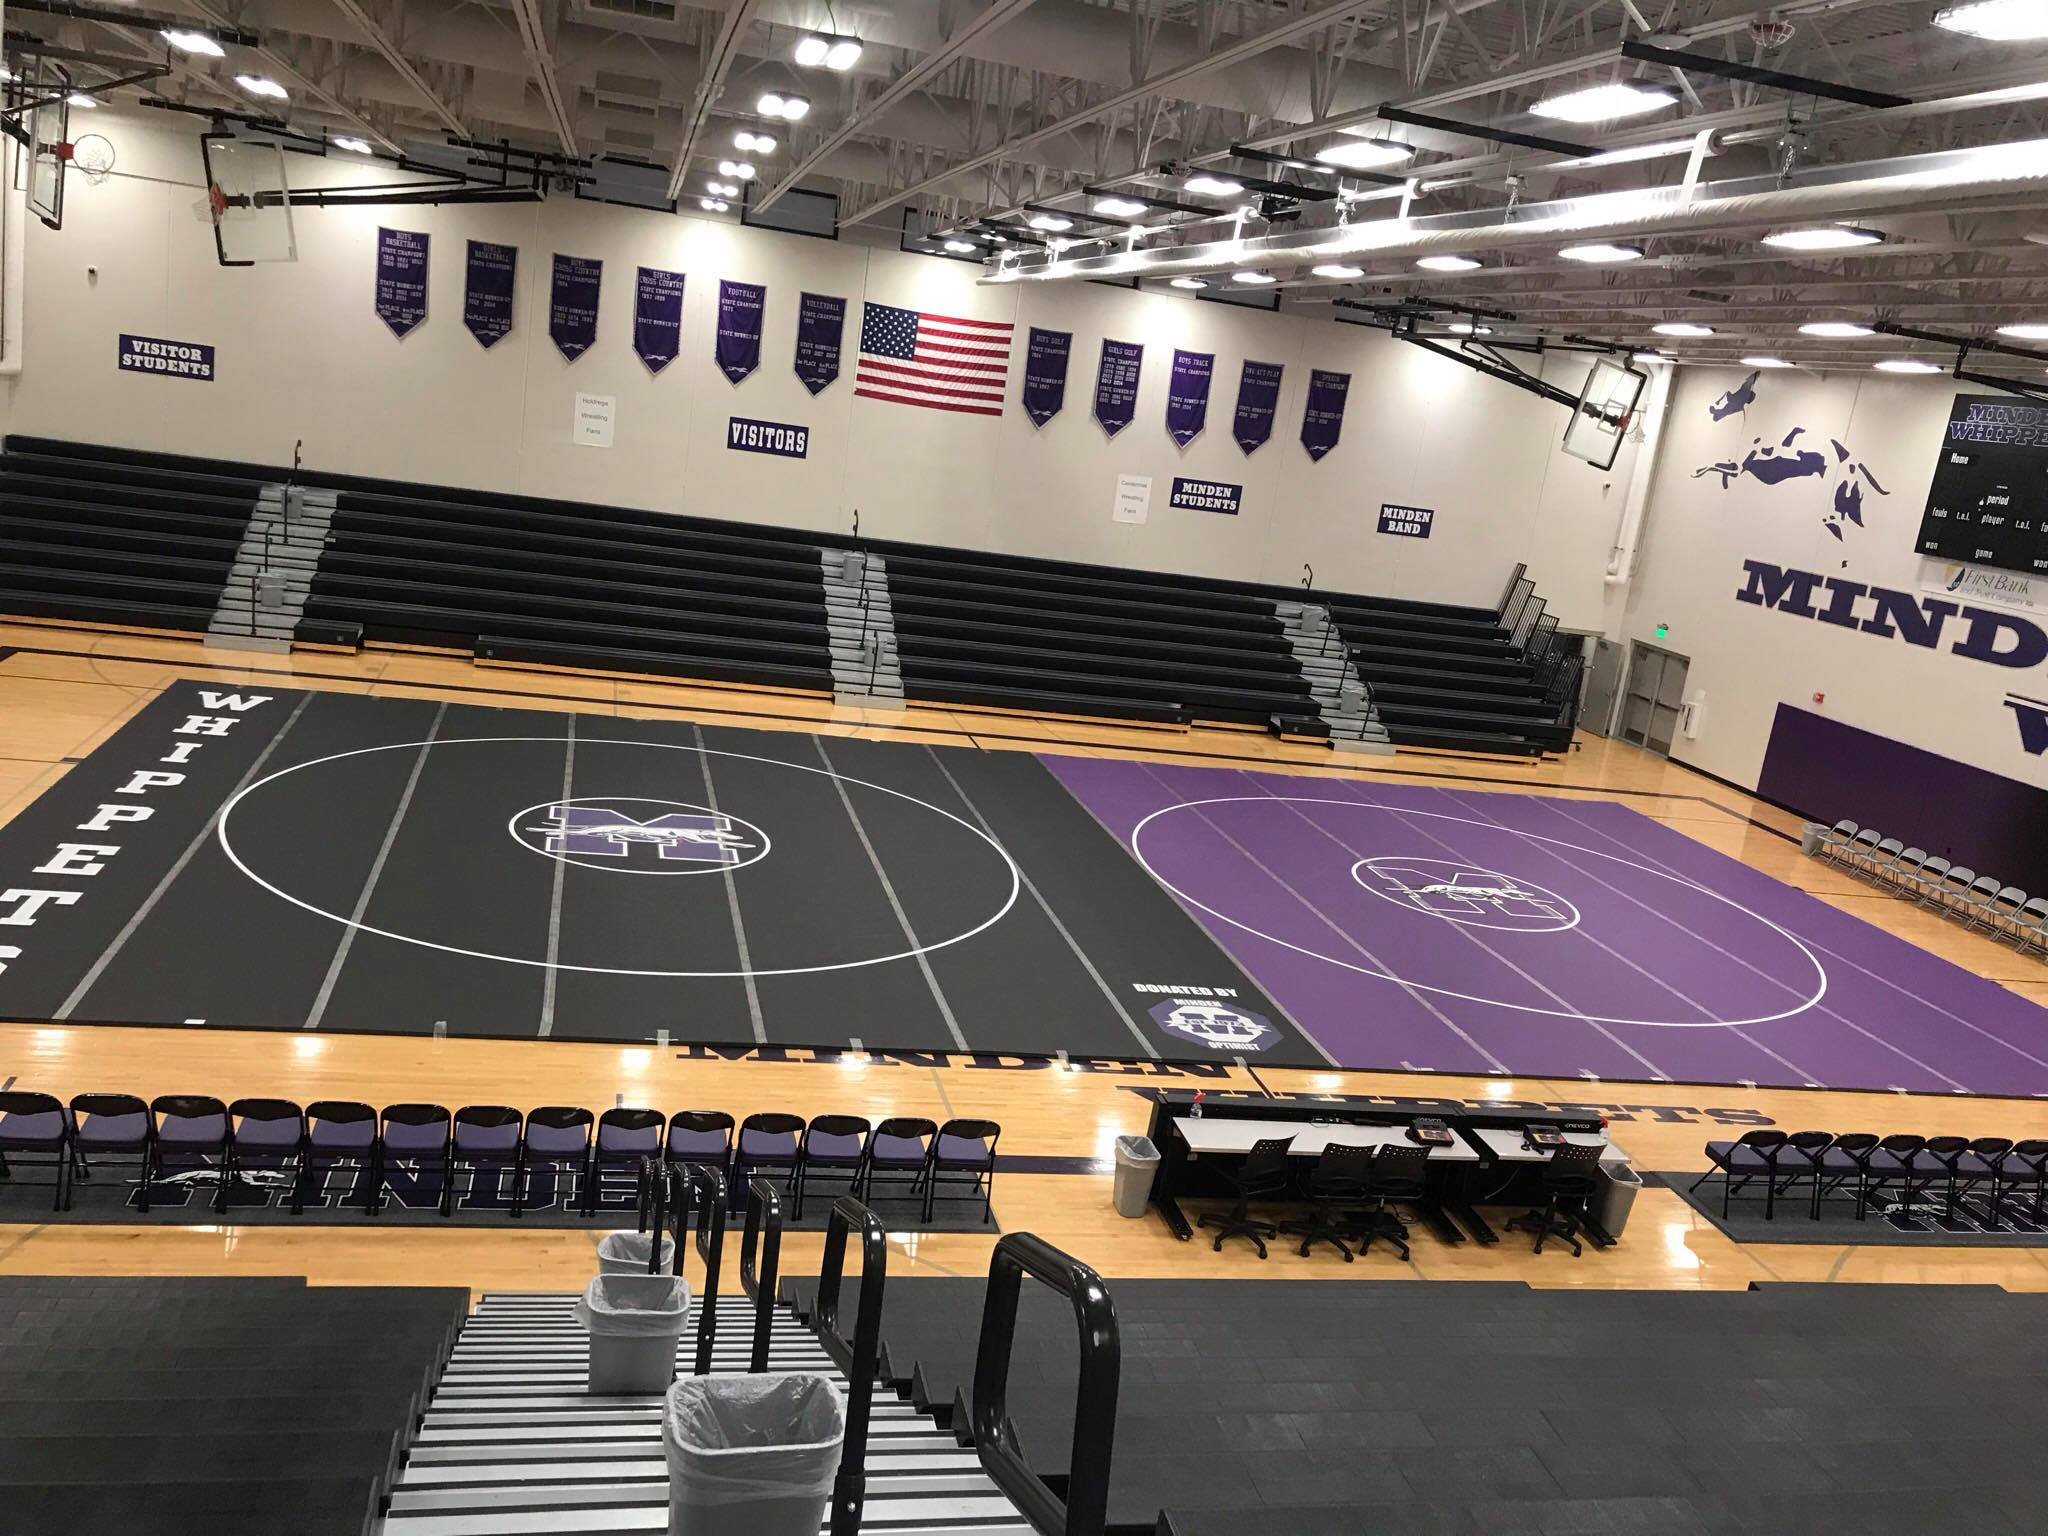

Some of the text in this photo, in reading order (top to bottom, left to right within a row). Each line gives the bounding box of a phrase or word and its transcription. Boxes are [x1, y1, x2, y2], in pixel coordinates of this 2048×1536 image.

[386, 238, 421, 249] BASKETBALL
[659, 280, 682, 288] COUNTRY
[729, 288, 756, 298] FOOTBALL
[807, 300, 840, 310] VOLLEYBALL
[132, 340, 202, 361] VISITOR
[122, 353, 210, 376] STUDENTS
[732, 422, 806, 453] VISITORS
[1951, 453, 1969, 464] Home
[1182, 482, 1232, 498] MINDEN
[1173, 493, 1237, 511] STUDENTS
[1986, 496, 2010, 505] period
[1382, 507, 1431, 523] MINDEN
[1932, 507, 1948, 518] fouls
[1981, 514, 2004, 525] player
[1388, 520, 1421, 534] BAND
[1925, 541, 1938, 550] won
[1975, 549, 1993, 559] game
[1736, 559, 2048, 668] MIND
[1133, 984, 1237, 997] DONATED BY
[1173, 999, 1222, 1008] MINDEN
[1207, 1041, 1260, 1050] OPTIMIST
